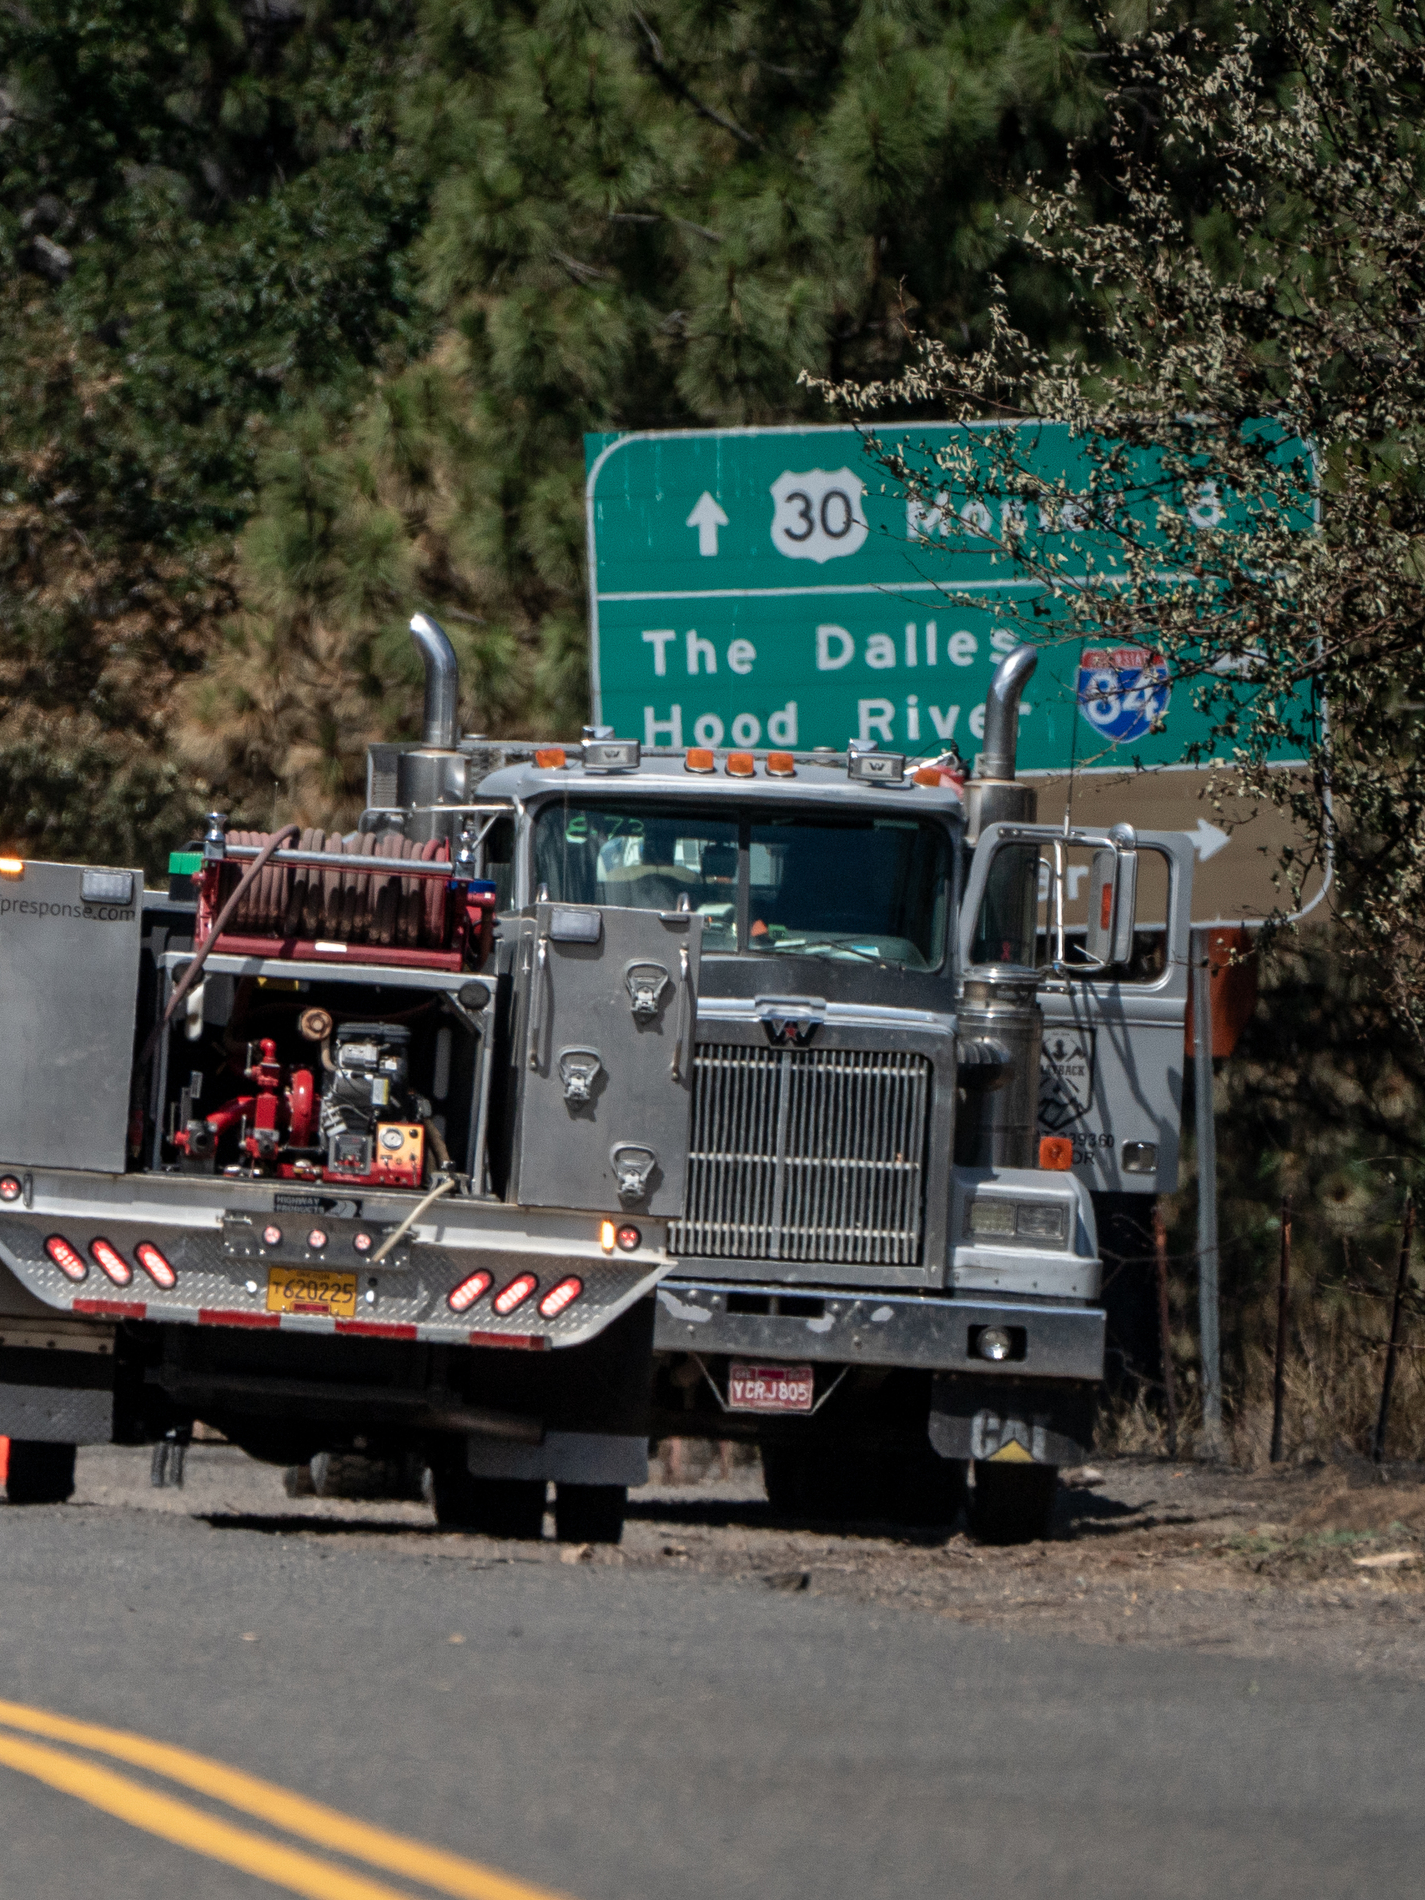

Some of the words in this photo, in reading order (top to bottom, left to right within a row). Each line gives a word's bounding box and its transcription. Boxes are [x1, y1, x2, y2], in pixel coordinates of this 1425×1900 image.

[783, 489, 854, 542] 30
[641, 628, 757, 677] The
[815, 619, 1021, 671] Dalles
[643, 700, 798, 748] Hood
[1087, 671, 1160, 726] 84
[733, 1380, 809, 1402] YCRJ805
